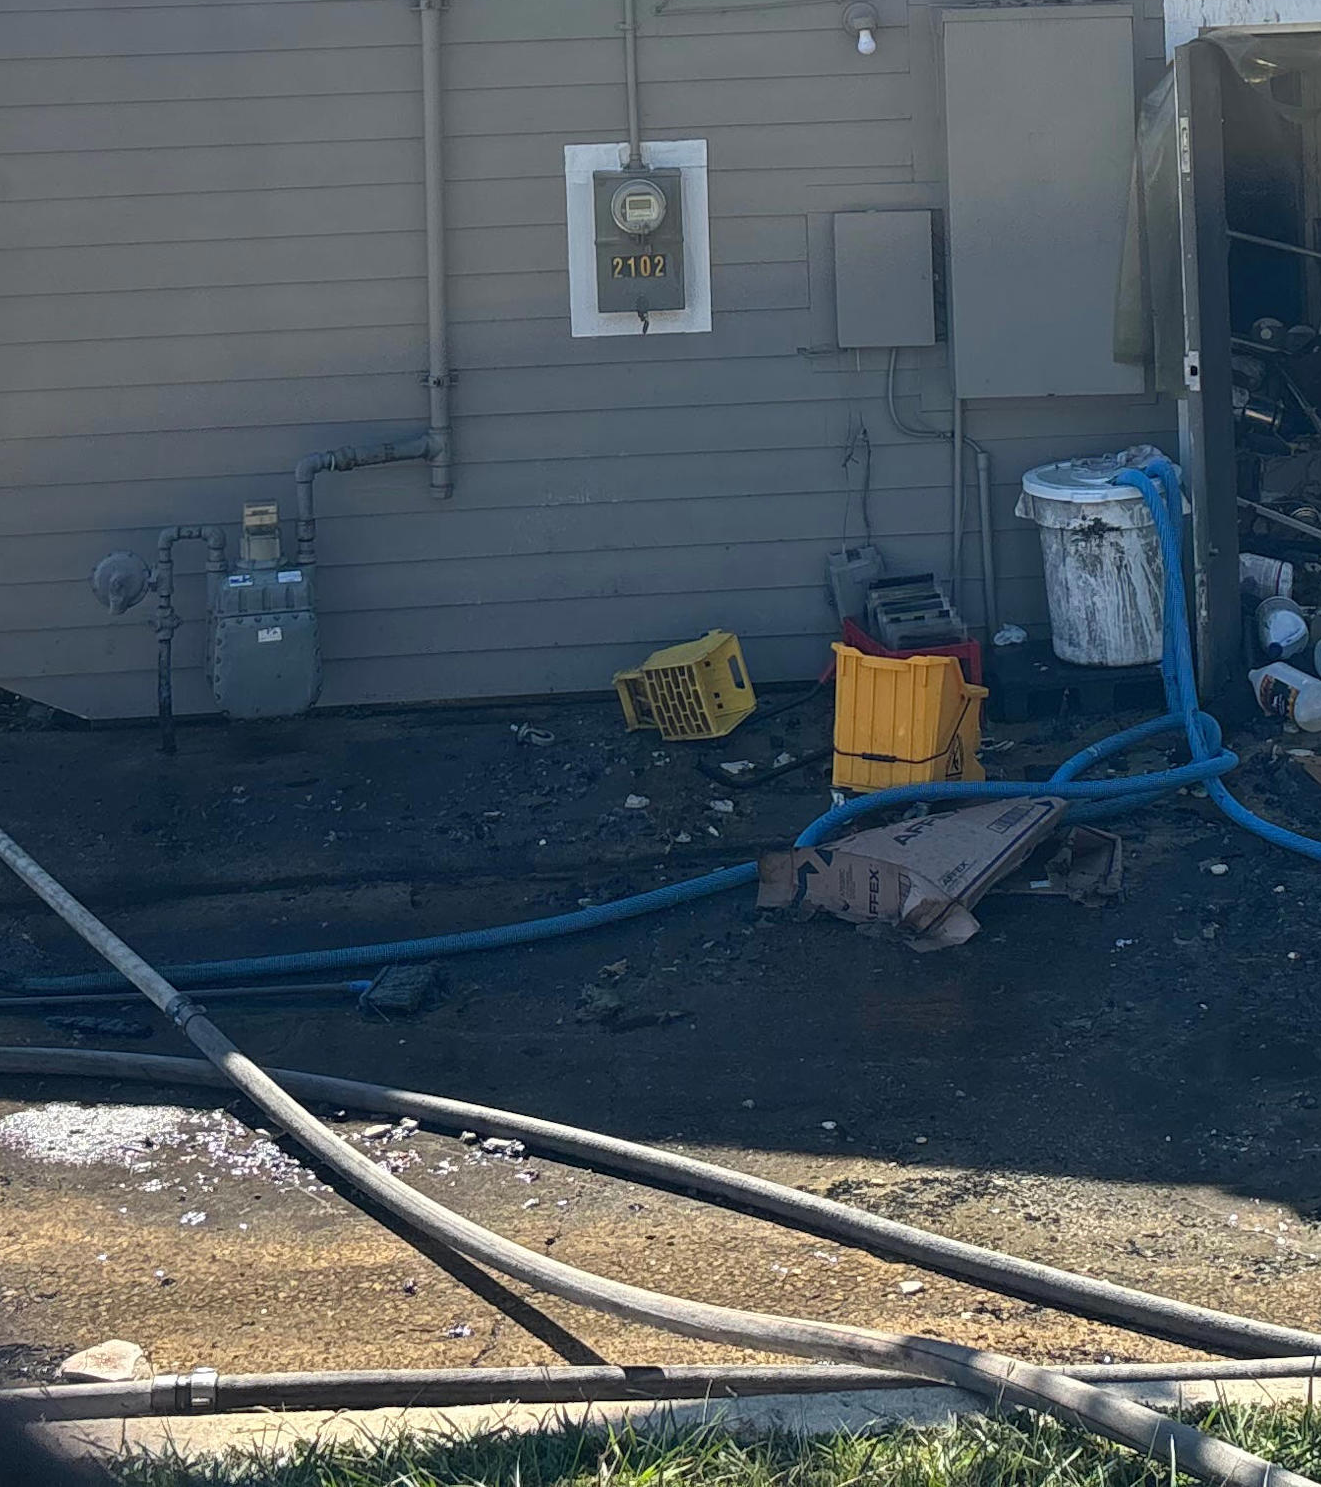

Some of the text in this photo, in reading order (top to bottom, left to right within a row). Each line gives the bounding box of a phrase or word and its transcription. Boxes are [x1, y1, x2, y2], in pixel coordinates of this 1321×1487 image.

[613, 255, 664, 278] 2102
[941, 860, 970, 887] AFFEX
[868, 867, 879, 919] FFEX
